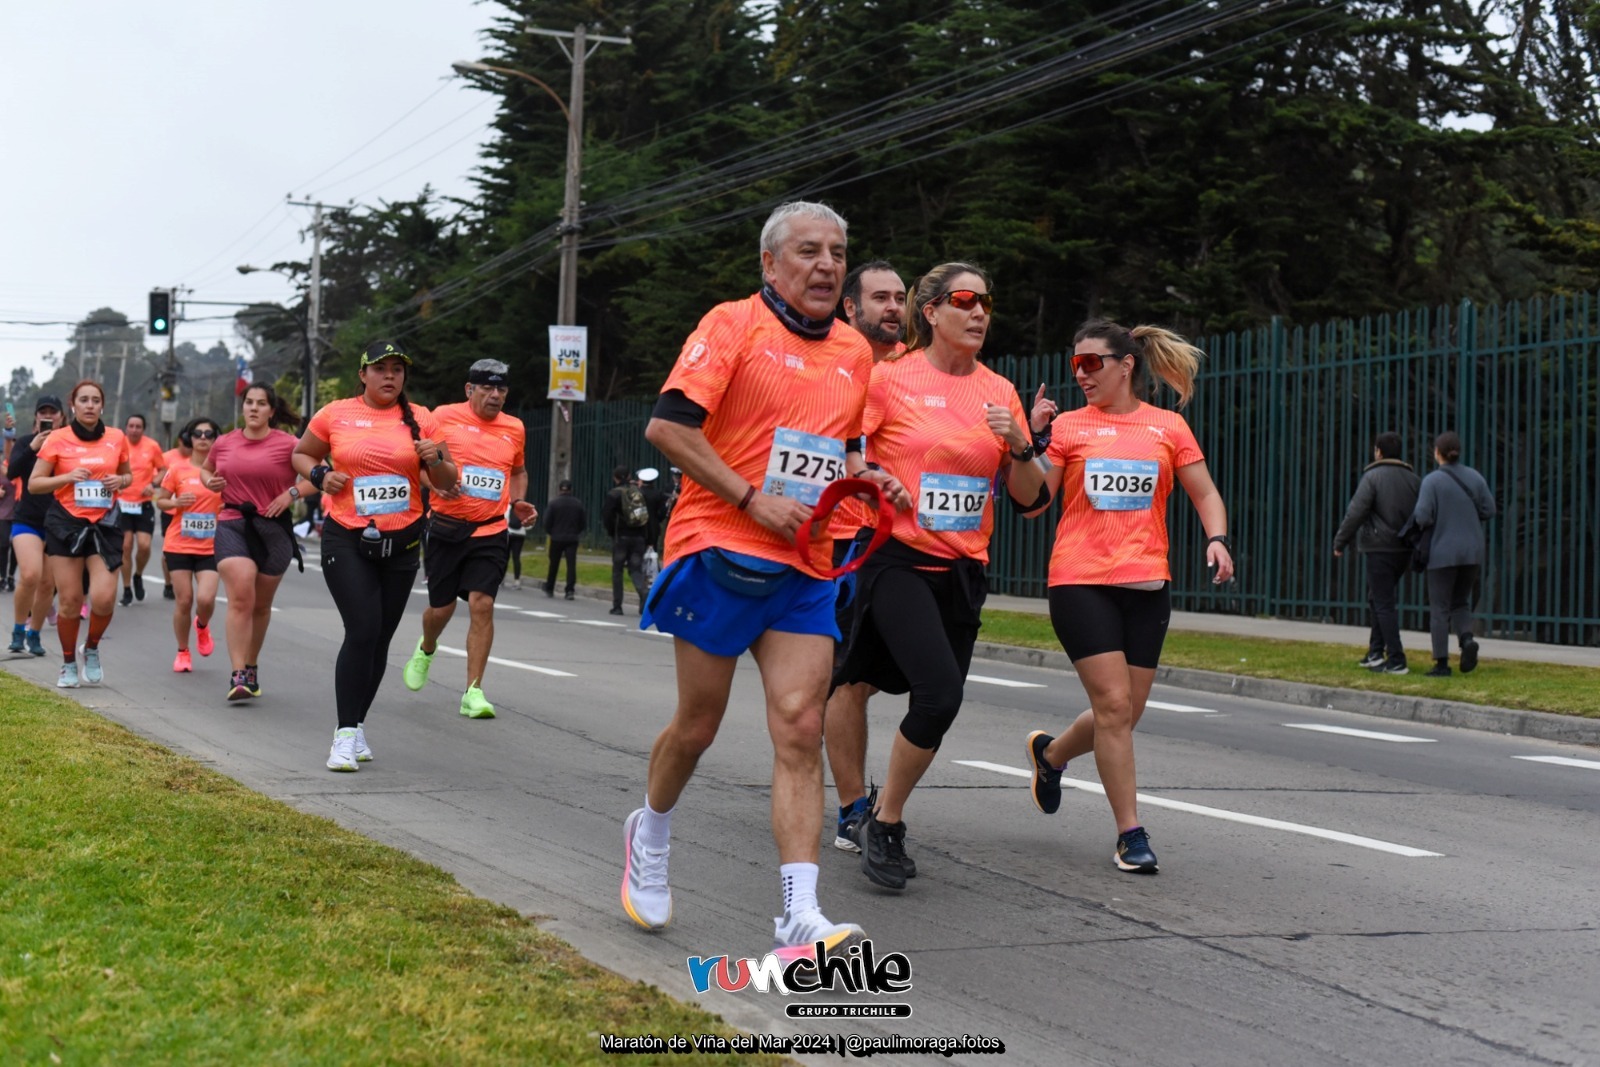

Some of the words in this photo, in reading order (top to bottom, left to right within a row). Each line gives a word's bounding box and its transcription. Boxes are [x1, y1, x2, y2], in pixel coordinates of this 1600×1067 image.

[557, 349, 580, 358] JUN
[558, 358, 580, 368] TS
[779, 450, 845, 482] 12756
[465, 475, 502, 490] 10573
[1090, 474, 1153, 493] 12036
[358, 486, 407, 501] 14236
[926, 491, 985, 512] 12105
[184, 519, 215, 530] 14825
